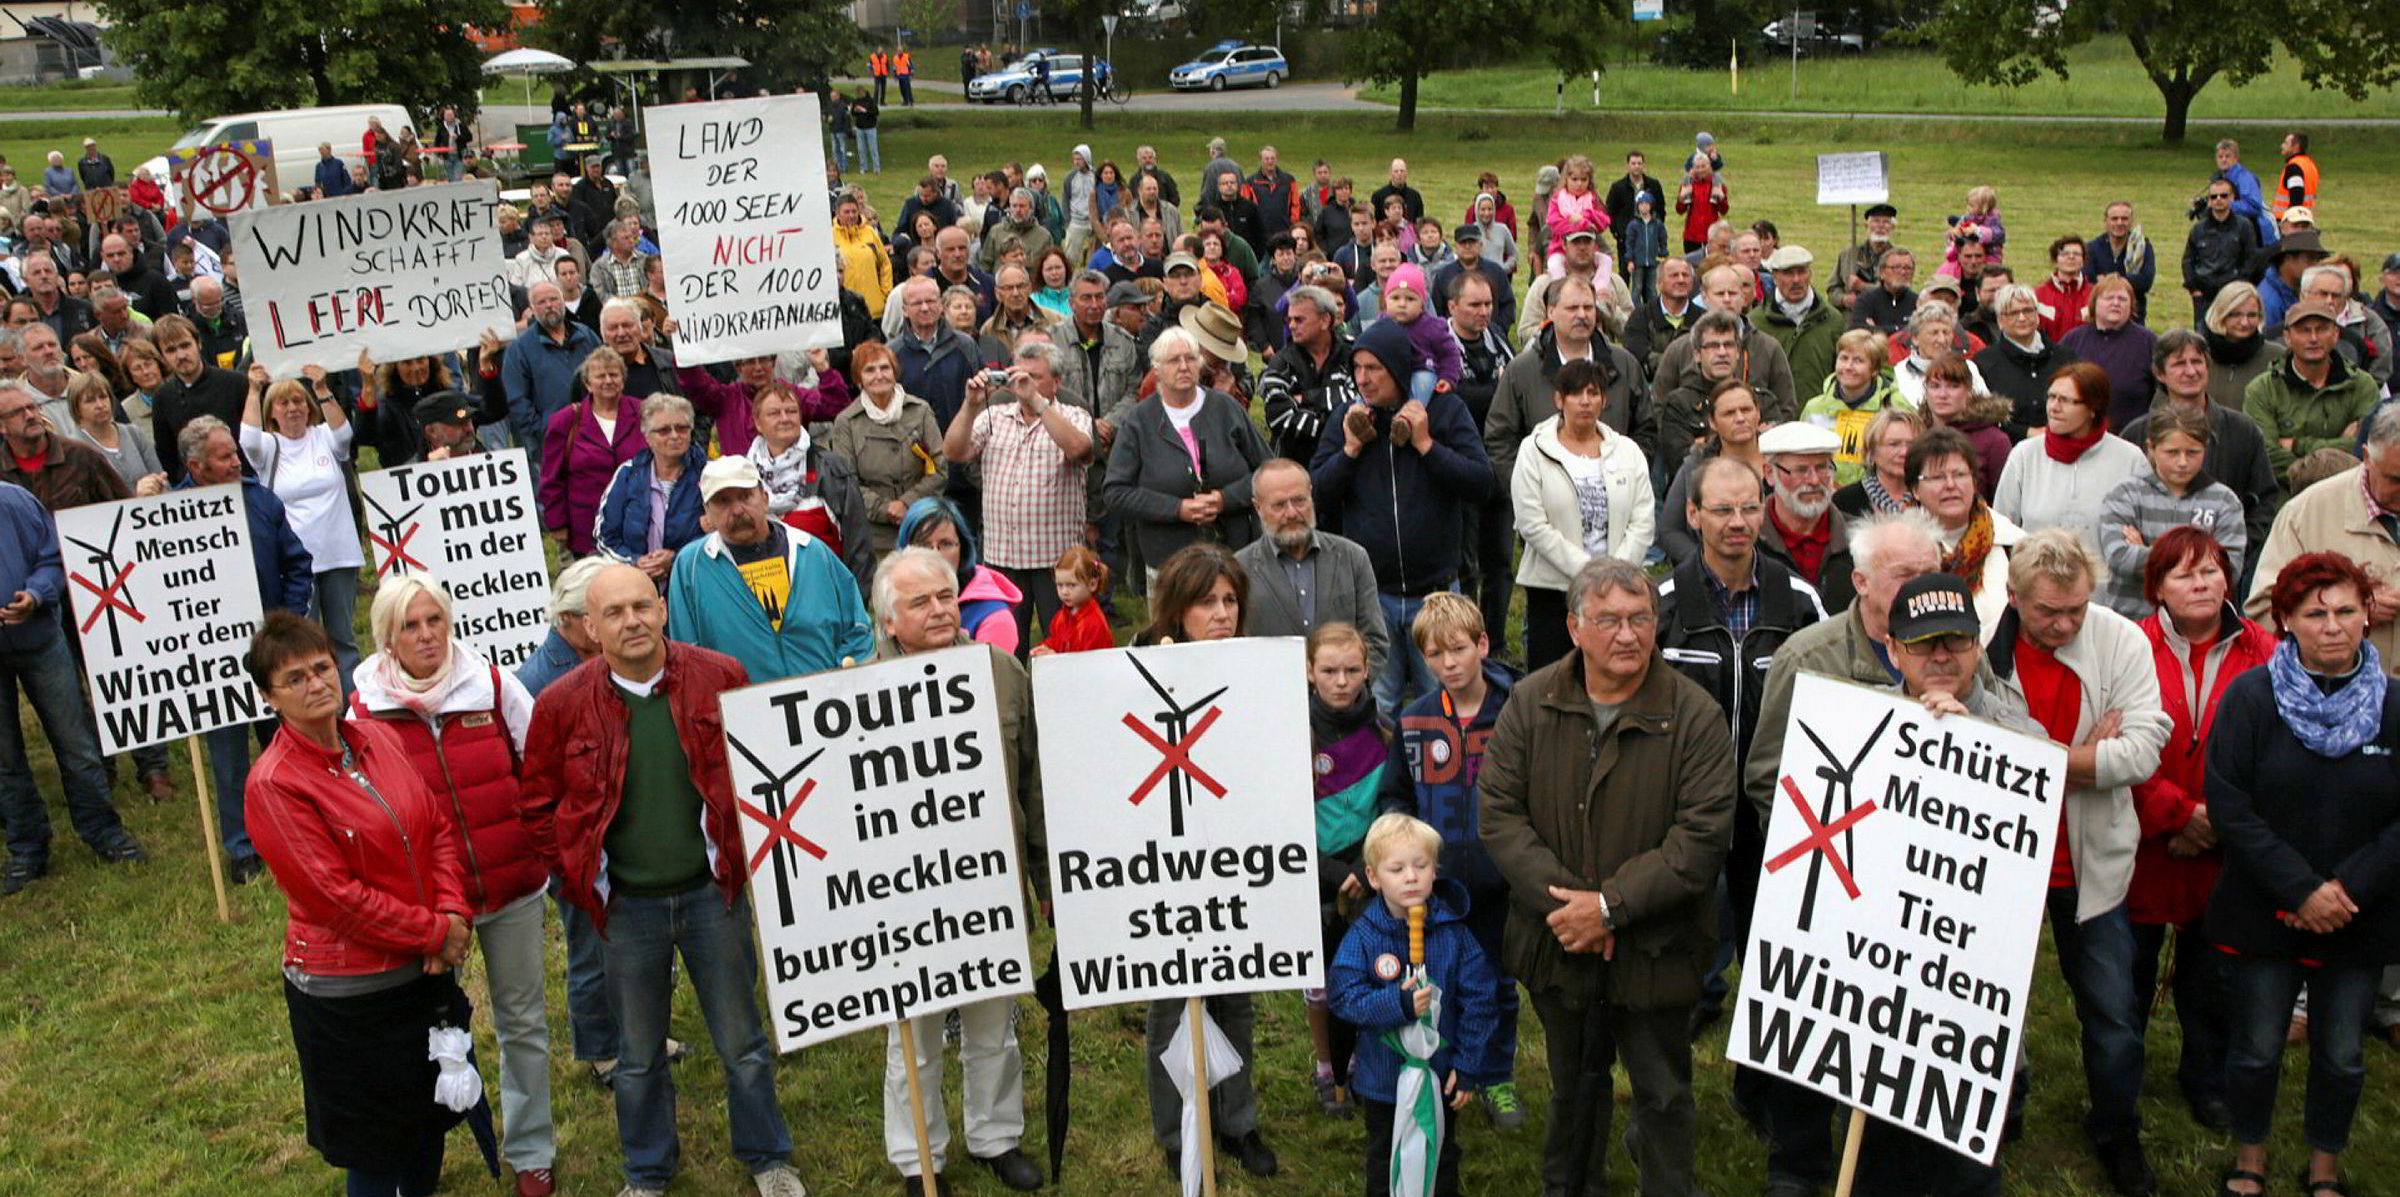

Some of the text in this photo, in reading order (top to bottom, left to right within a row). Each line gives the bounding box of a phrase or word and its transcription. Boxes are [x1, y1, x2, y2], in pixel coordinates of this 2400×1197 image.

[679, 117, 764, 159] LAND
[707, 158, 758, 186] DER
[252, 198, 499, 270] WINDKRAFT
[674, 193, 803, 226] 1000 SEEN
[351, 237, 485, 274] SCHAFFT
[713, 228, 803, 266] NICHT
[680, 267, 822, 303] DER 1000
[269, 275, 512, 351] LEERE DÖRFER
[389, 453, 518, 502] Touris
[130, 495, 236, 530] Schützt
[439, 495, 524, 531] mus
[2191, 508, 2216, 527] 26
[135, 526, 239, 563] Mensch
[444, 531, 527, 562] in der
[163, 559, 216, 589] und
[168, 597, 221, 622] Tier
[146, 621, 256, 656] vor dem
[770, 663, 975, 747] Touris
[849, 731, 983, 792] mus
[1894, 721, 2051, 803] Schützt
[854, 788, 985, 841] in der
[1882, 774, 2039, 859] Mensch
[826, 848, 1007, 911] Mecklen
[1058, 840, 1308, 893] Radwege
[1905, 844, 1988, 895] und
[1128, 894, 1248, 939] statt
[1898, 890, 1976, 950] Tier
[773, 905, 1015, 984] burgischen
[1069, 942, 1314, 996] Windräder
[784, 955, 1022, 1039] Seenplatte
[1846, 931, 2012, 1017] vor dem
[1759, 939, 2011, 1081] Windrad
[1748, 998, 1998, 1156] WAHN!
